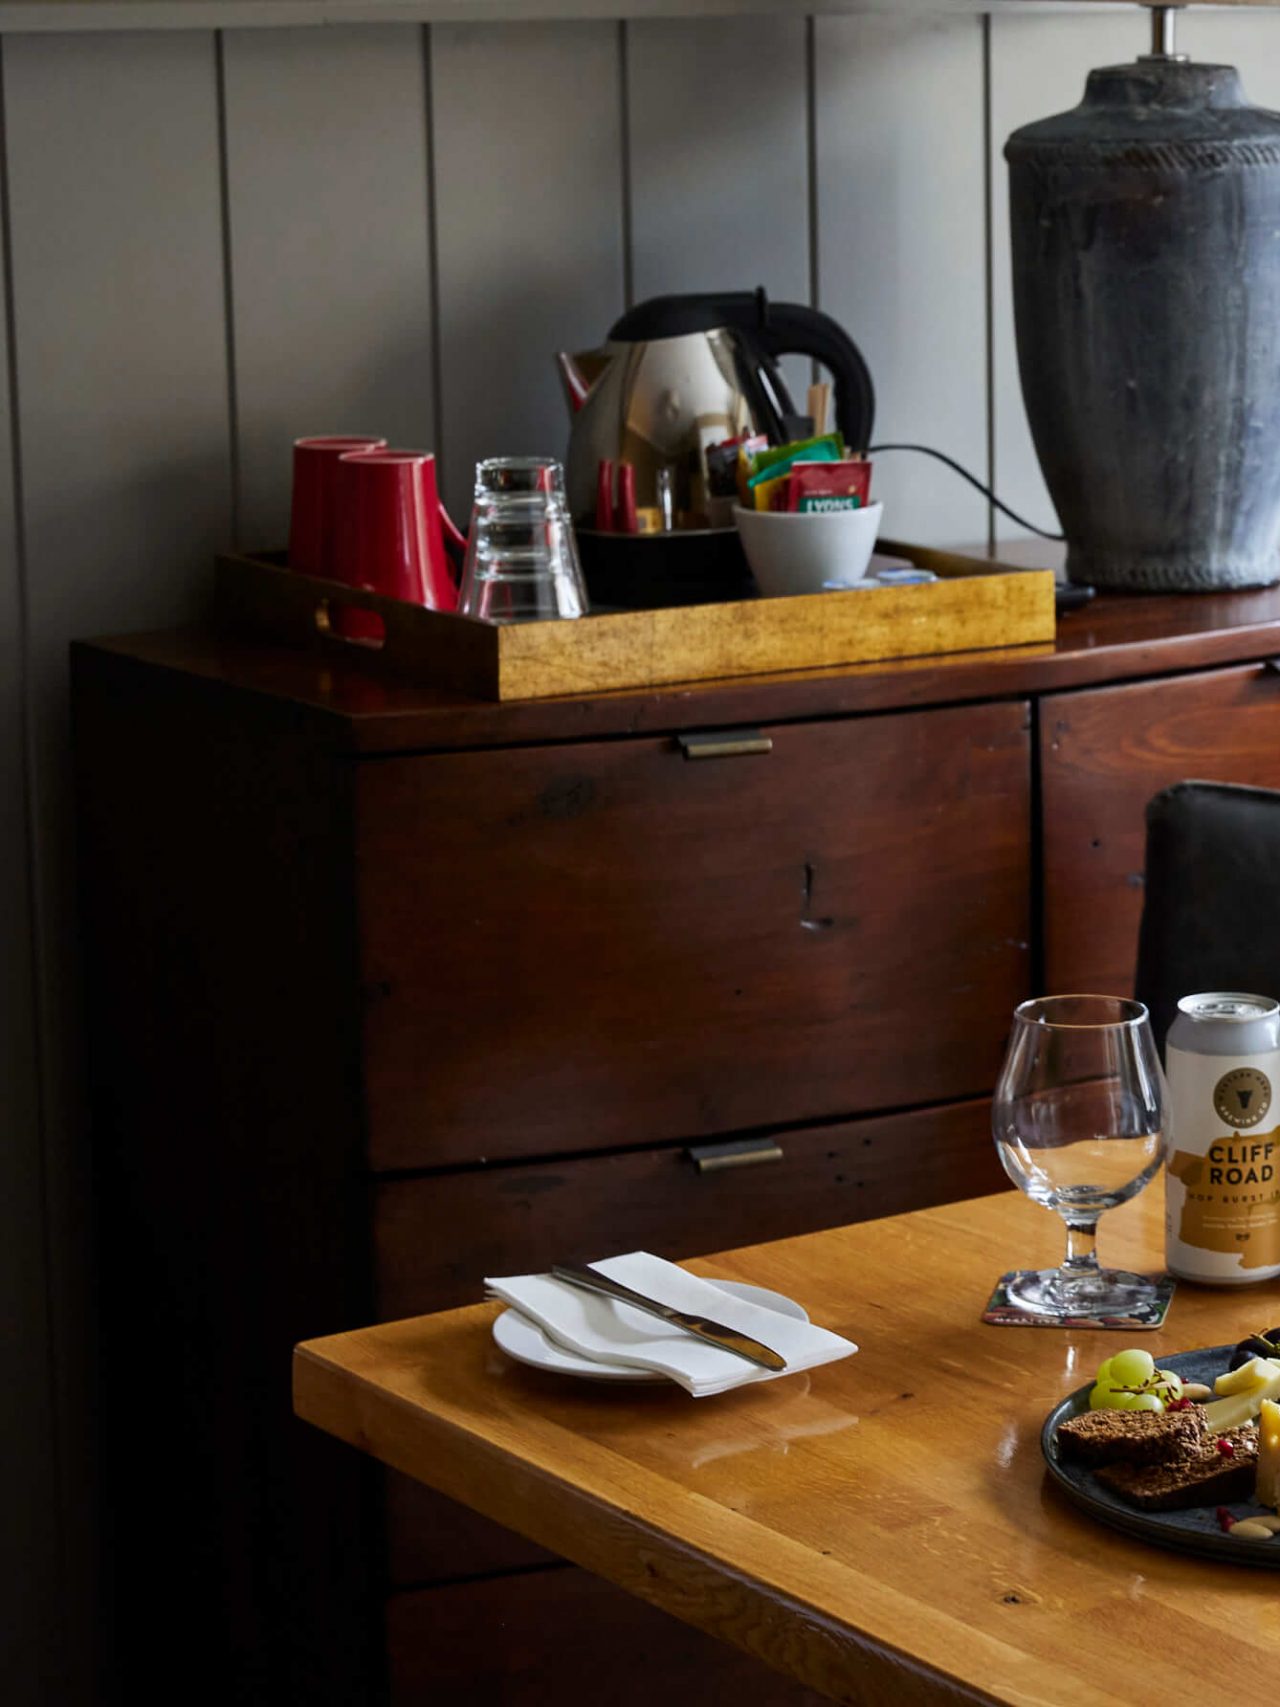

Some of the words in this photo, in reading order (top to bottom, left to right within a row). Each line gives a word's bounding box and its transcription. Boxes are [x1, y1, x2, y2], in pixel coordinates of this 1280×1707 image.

[1209, 1142, 1274, 1163] CLIFF
[1210, 1165, 1273, 1185] ROAD
[1222, 1192, 1263, 1204] BURST
